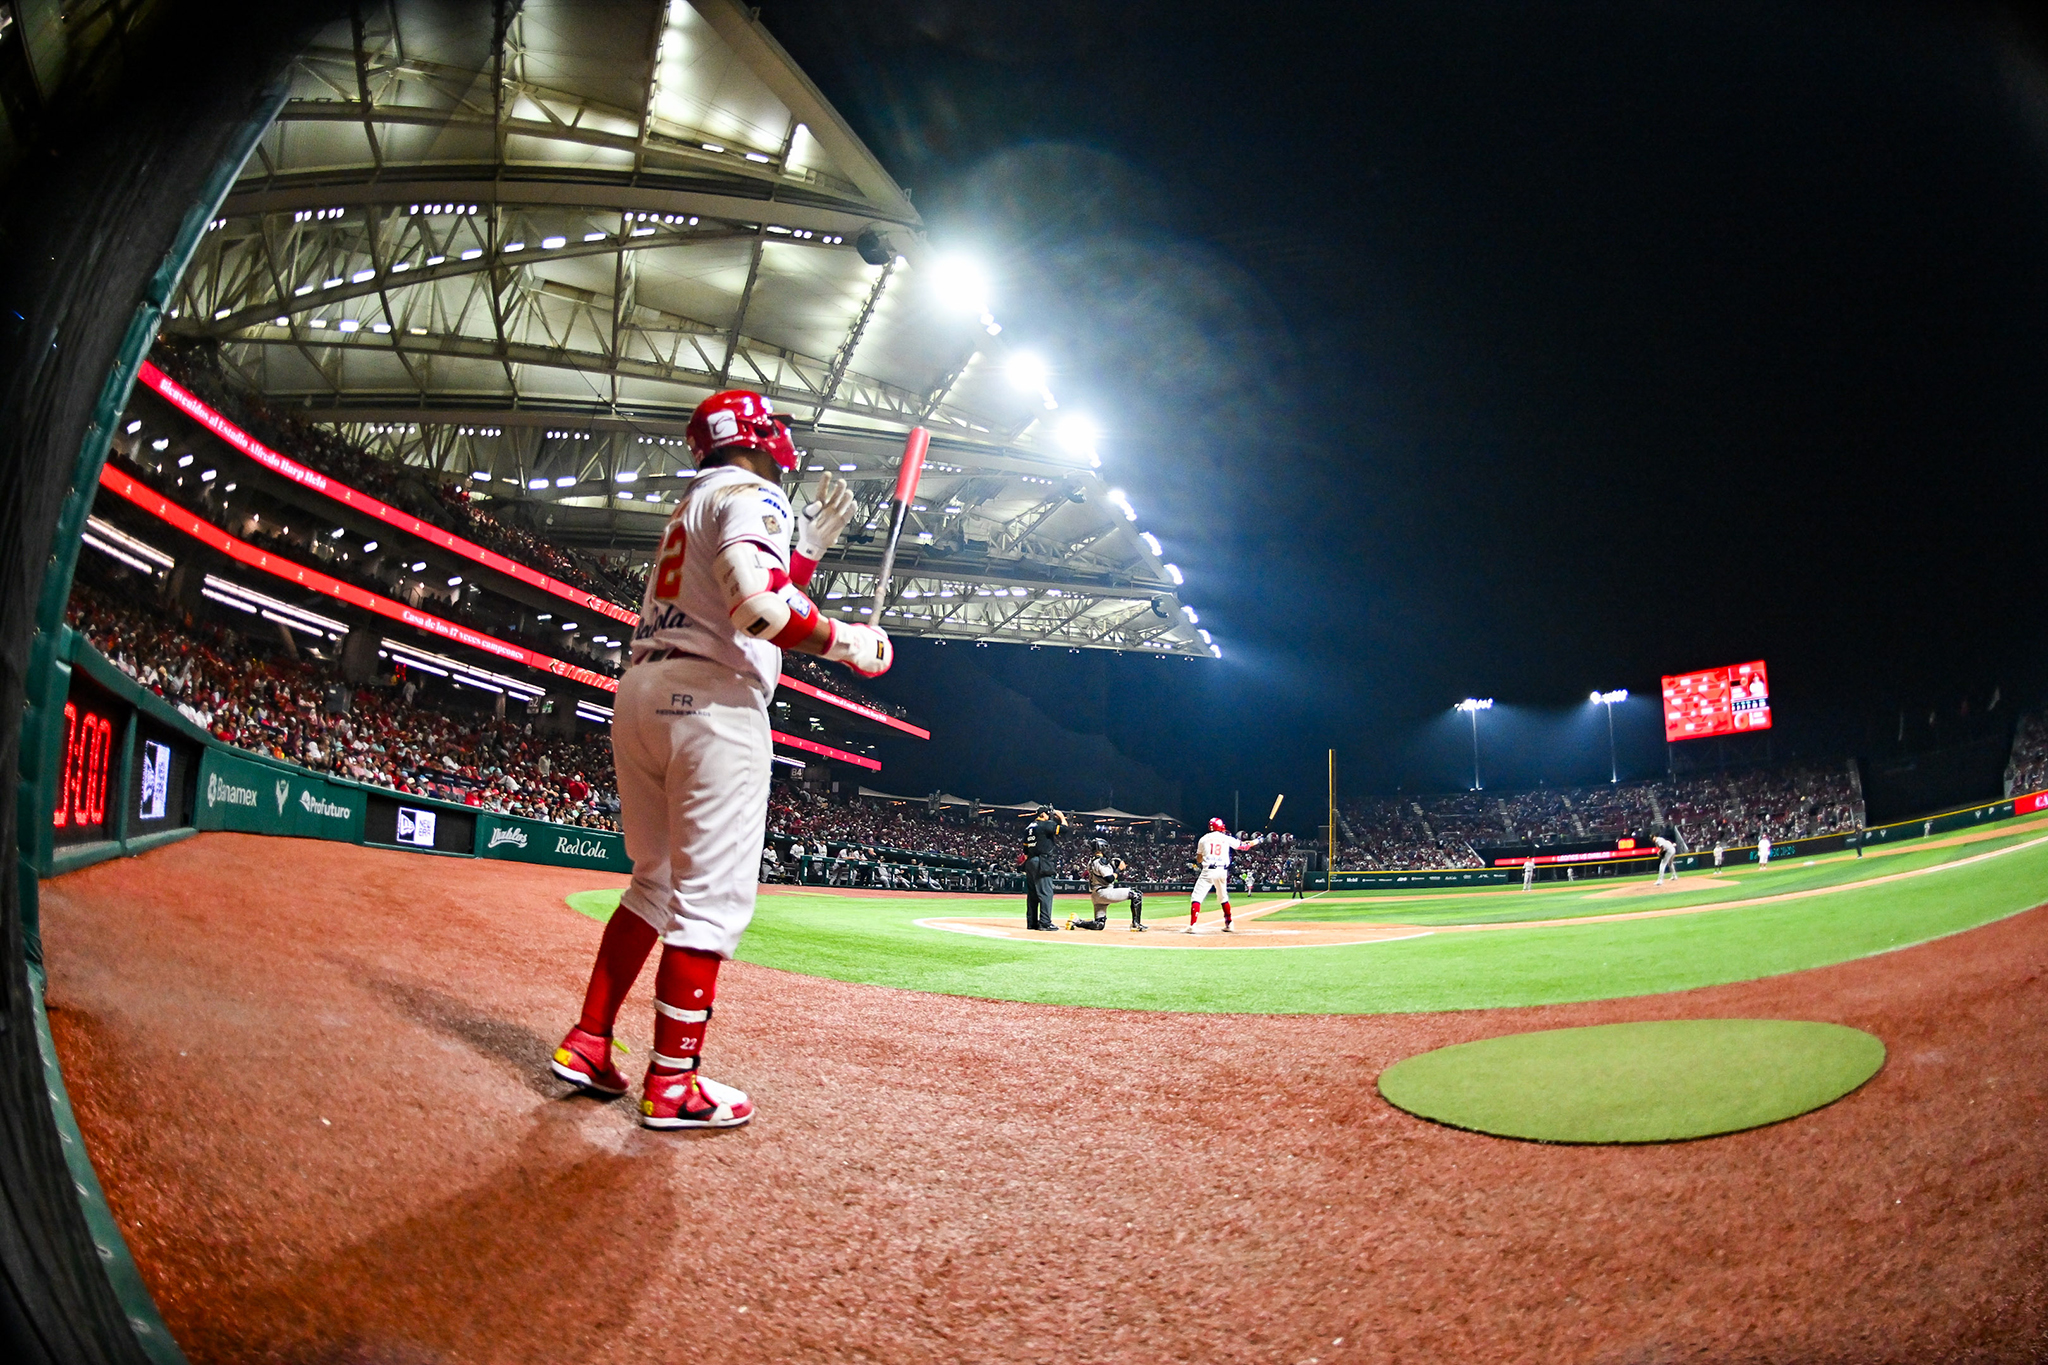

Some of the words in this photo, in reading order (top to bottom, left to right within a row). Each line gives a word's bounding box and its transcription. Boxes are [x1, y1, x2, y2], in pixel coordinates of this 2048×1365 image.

[160, 378, 209, 421] Bienvenidos
[217, 419, 248, 447] Estadio
[248, 442, 280, 468] Alfredo
[280, 459, 305, 481] Harp
[403, 610, 424, 625] Casa
[425, 618, 436, 629] de
[436, 621, 449, 634] los
[481, 640, 524, 660] campeones
[671, 693, 693, 707] FR
[217, 777, 258, 807] Banamex
[310, 796, 351, 819] Profuturo
[1210, 843, 1222, 856] 18
[680, 1037, 698, 1050] 22
